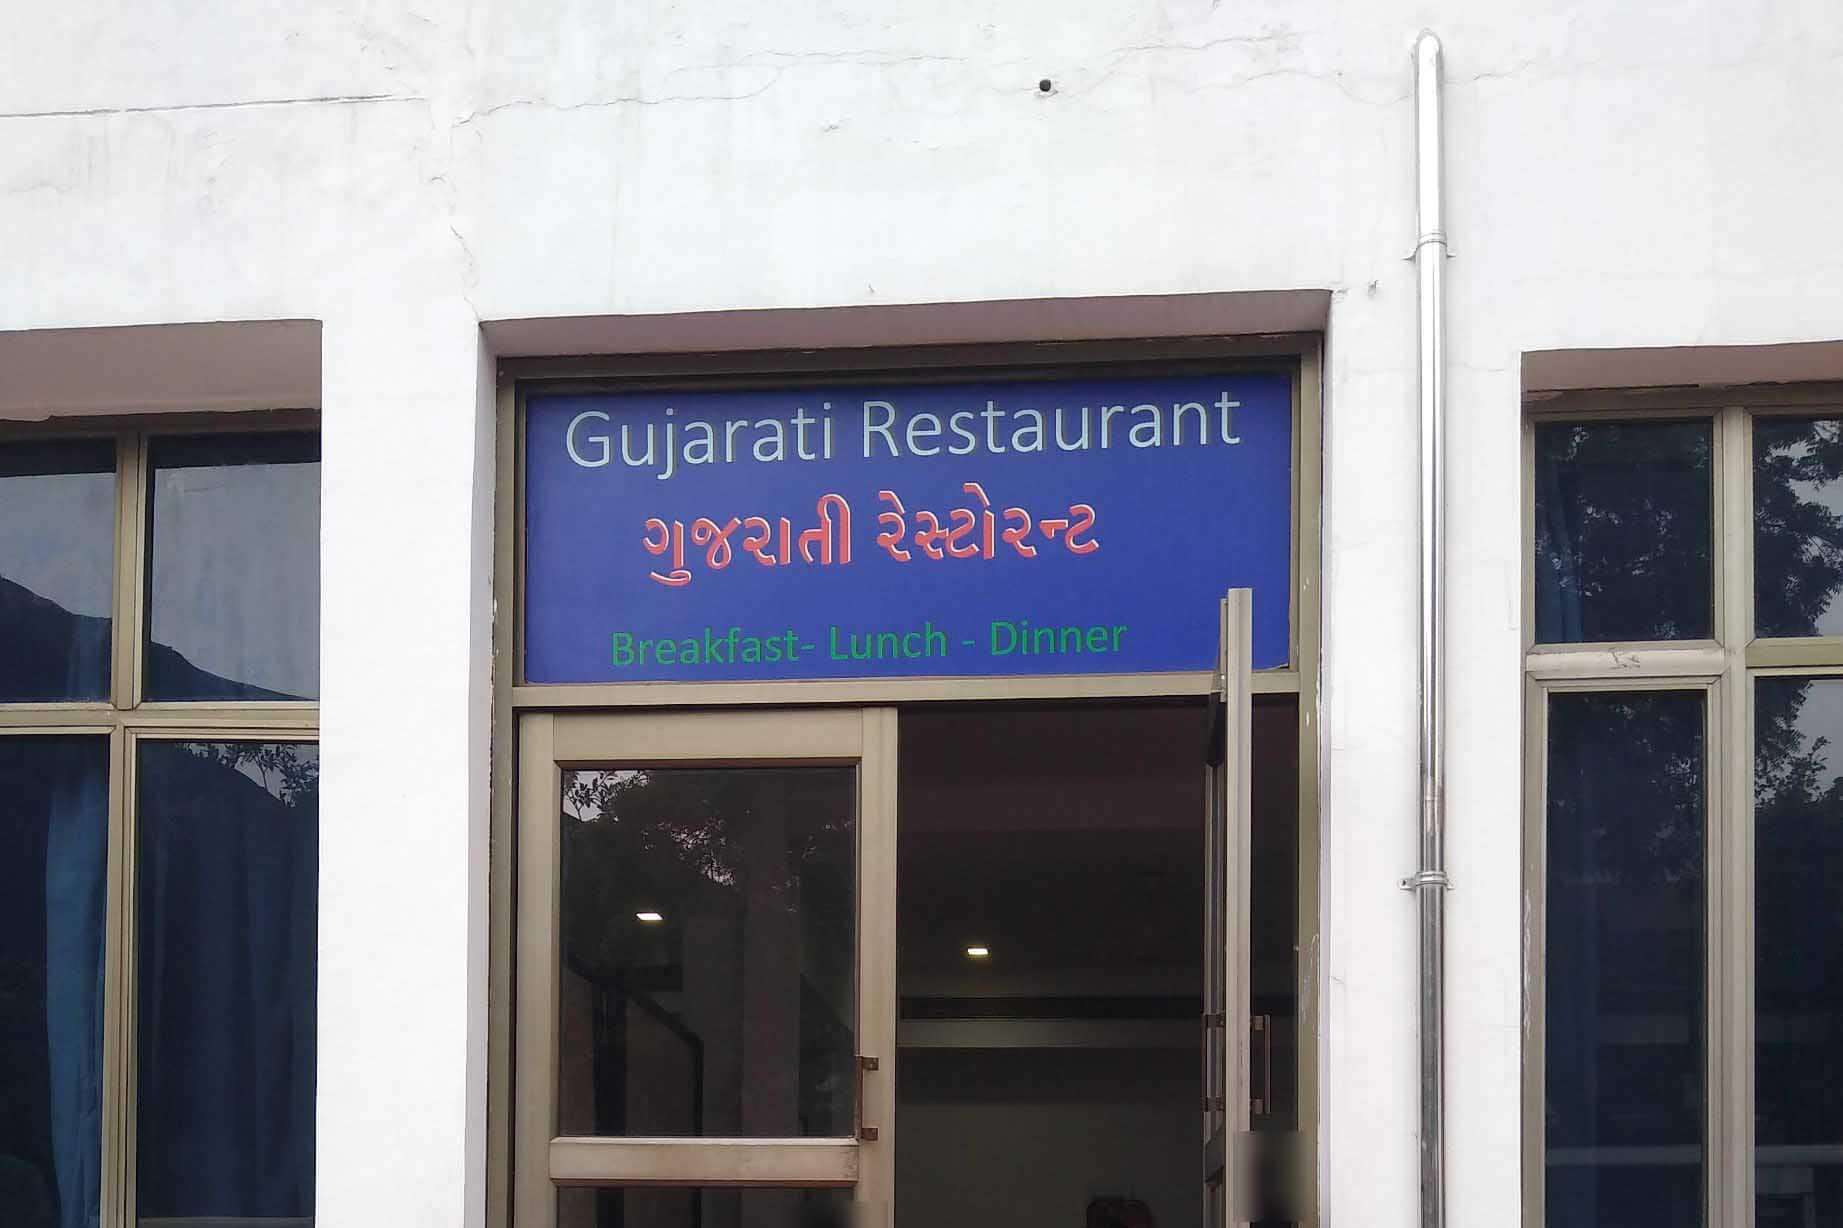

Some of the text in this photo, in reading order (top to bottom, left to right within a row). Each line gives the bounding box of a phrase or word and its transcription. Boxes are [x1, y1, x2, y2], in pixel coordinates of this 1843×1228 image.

[565, 391, 1241, 480] Gujarati Restaurant
[642, 482, 1100, 586] ગુજરાતી રેસ્ટોરન્ટ
[829, 621, 947, 661] Lunch
[990, 620, 1128, 655] Dinner
